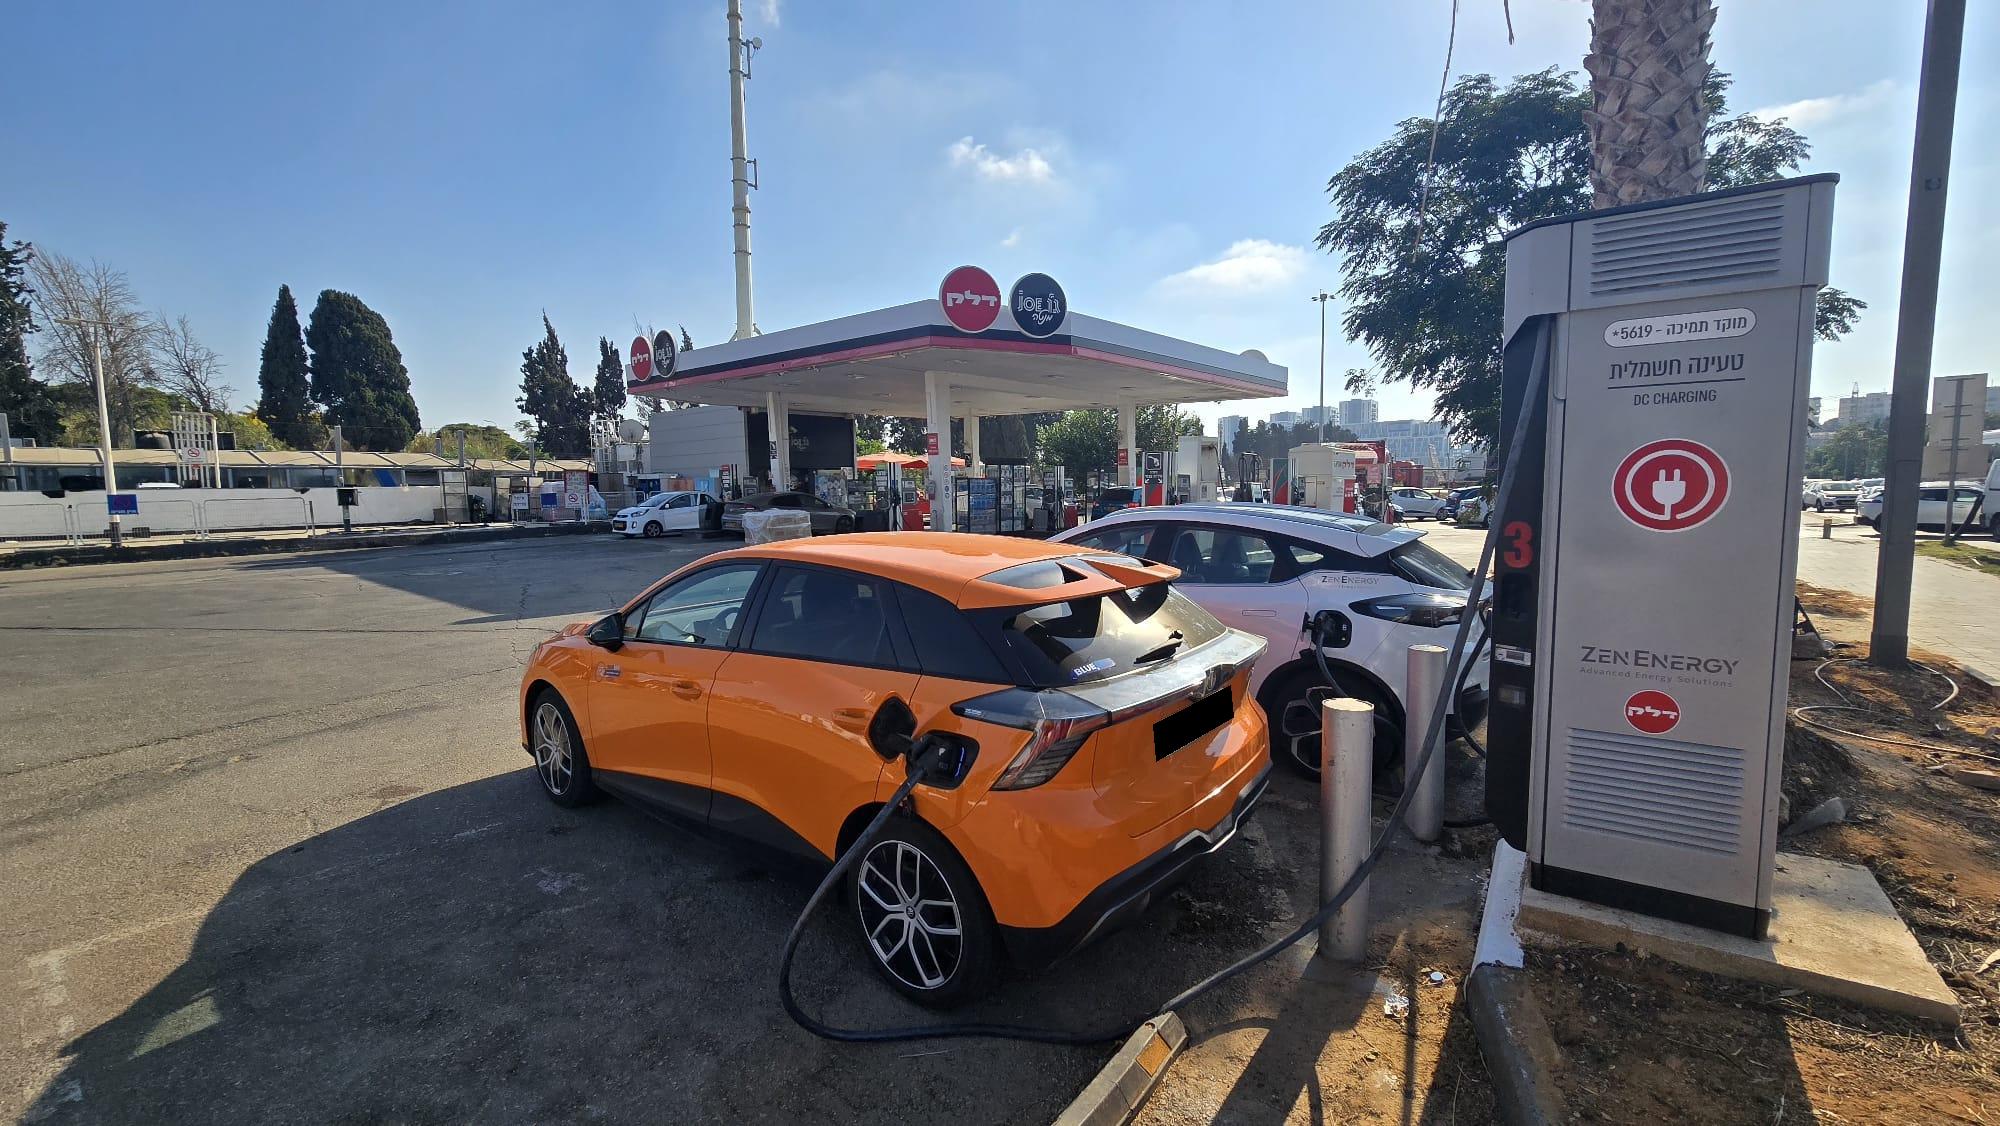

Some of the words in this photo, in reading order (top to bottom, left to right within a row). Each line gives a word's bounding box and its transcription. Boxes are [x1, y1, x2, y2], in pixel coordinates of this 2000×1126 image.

[946, 289, 998, 307] דלק
[1666, 320, 1709, 336] תמיכה
[1713, 316, 1748, 333] מוקד
[1608, 358, 1682, 380] חשמלית
[1688, 353, 1745, 374] טעינה
[1633, 393, 1650, 406] DC
[1653, 389, 1717, 405] CHARGING
[1503, 520, 1534, 569] 3
[1073, 662, 1097, 677] BLUE
[1579, 665, 1632, 678] Advanced
[1635, 671, 1673, 684] Energy
[1678, 675, 1734, 688] Solutions
[1627, 705, 1679, 720] דלק
